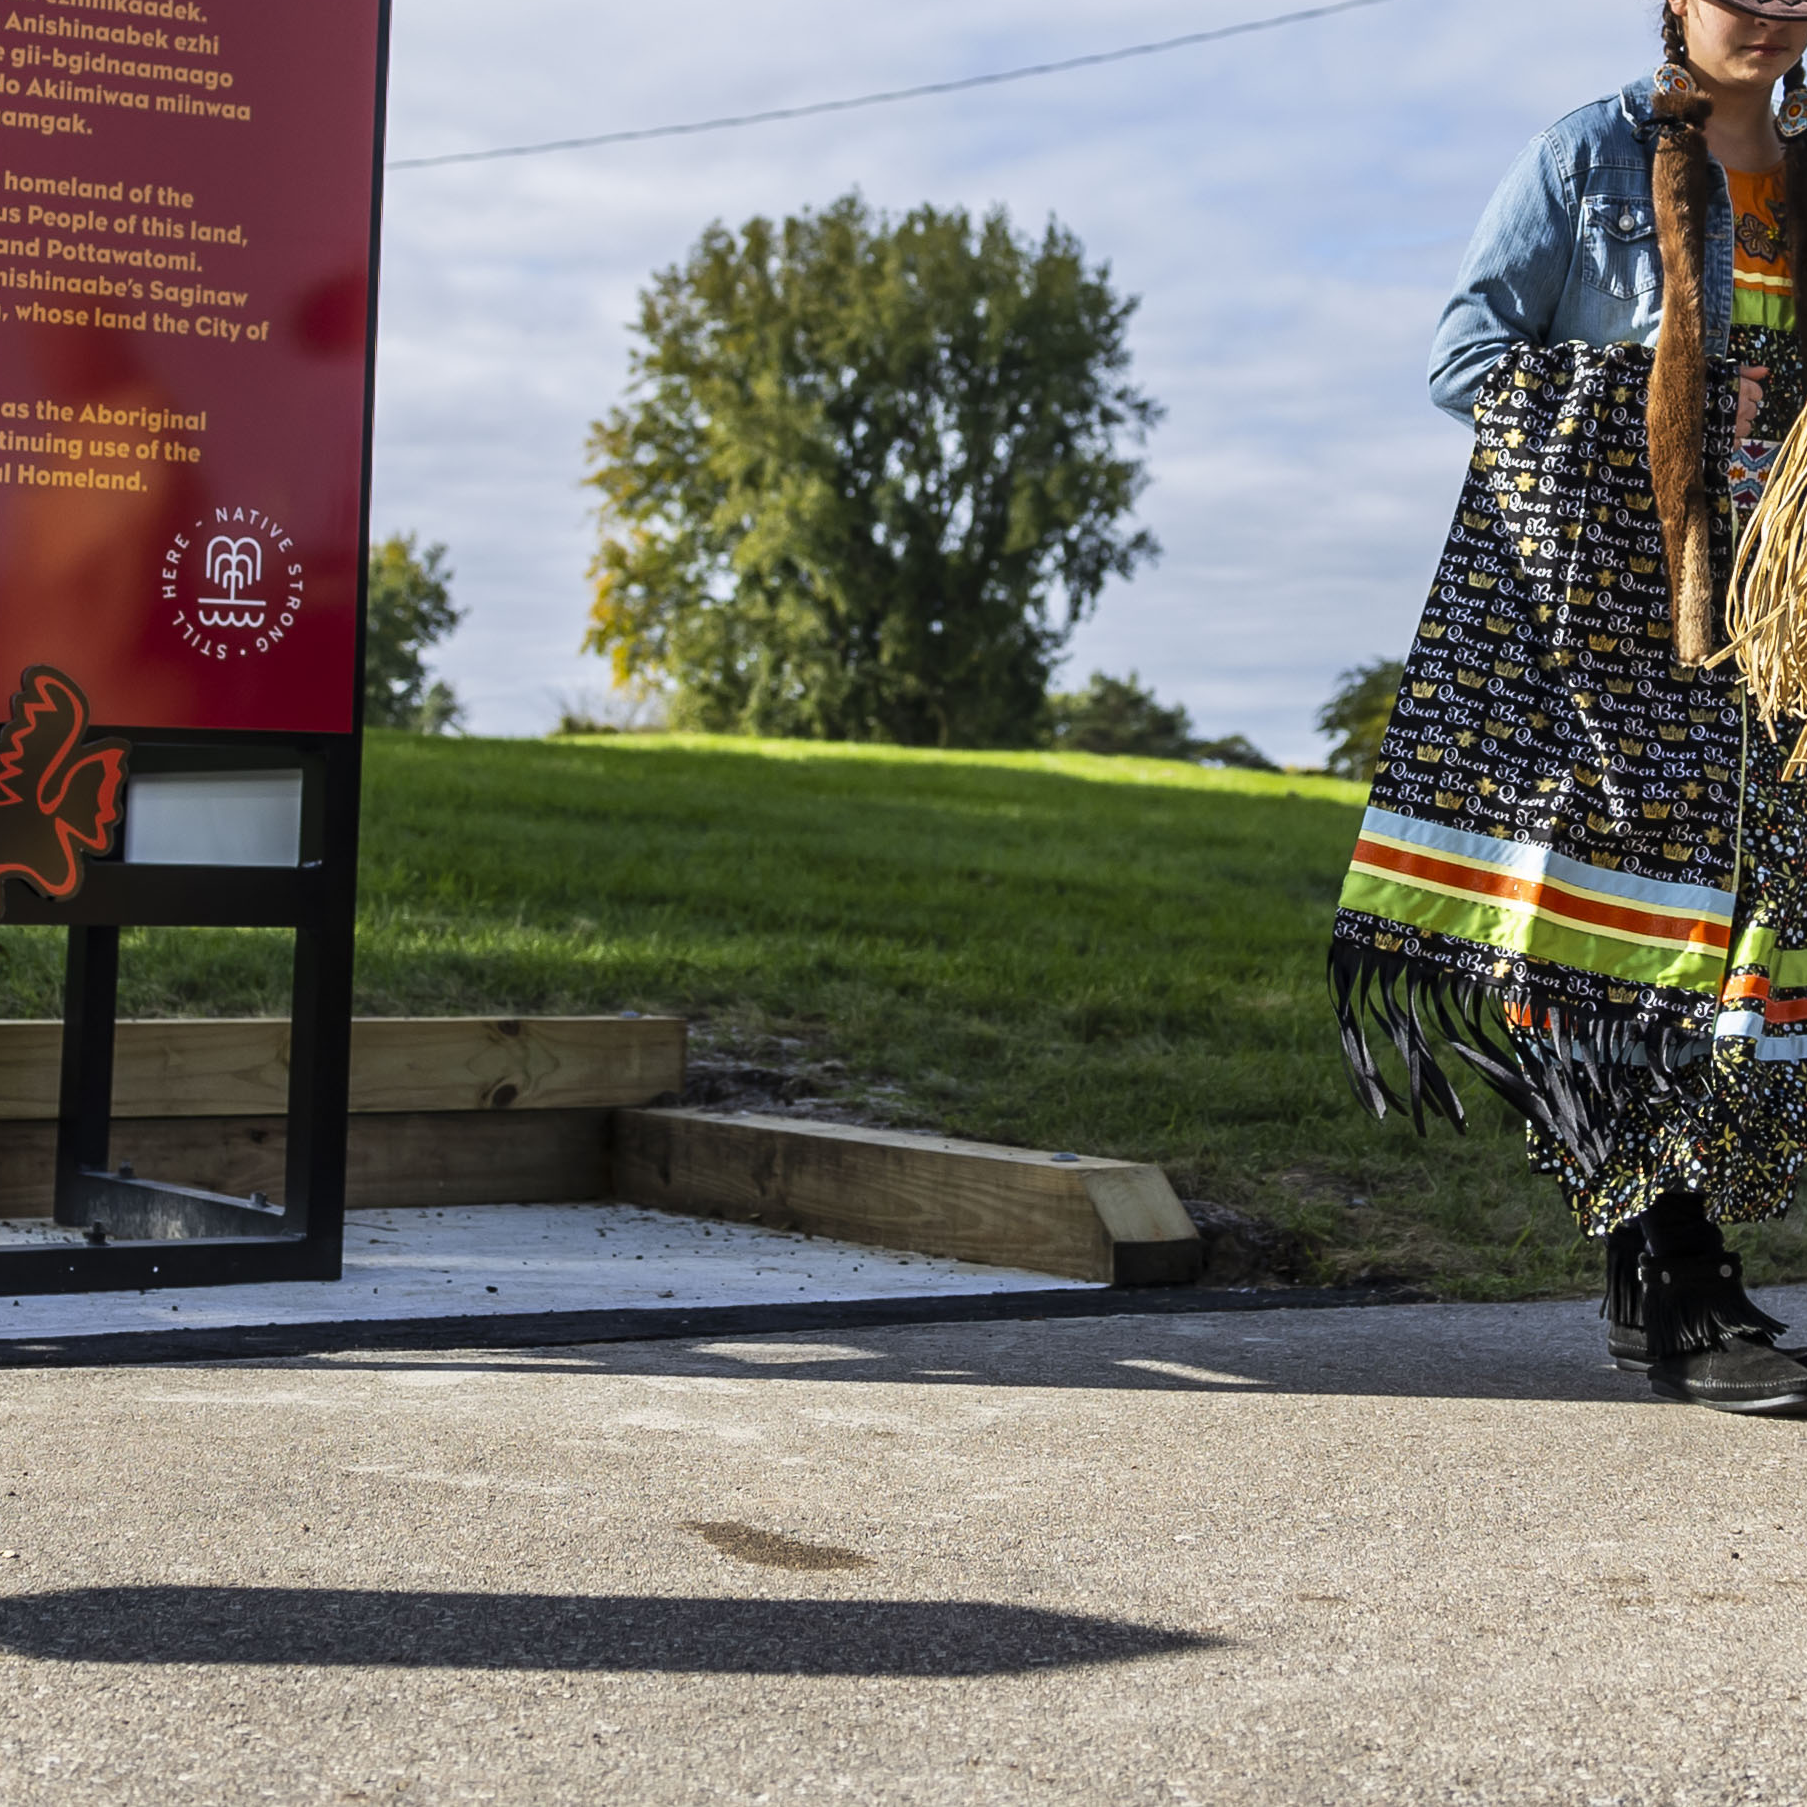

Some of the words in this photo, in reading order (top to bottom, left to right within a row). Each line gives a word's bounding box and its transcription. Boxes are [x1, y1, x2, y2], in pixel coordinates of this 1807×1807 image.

[4, 10, 169, 50] Anishinaabek
[174, 33, 219, 56] ezhi
[10, 44, 234, 91] gii-bgidnaamaago
[25, 77, 150, 110] Akiimiwaa
[155, 93, 251, 121] miinwaa
[4, 169, 124, 202] homeland
[128, 184, 153, 204] of
[157, 186, 195, 209] the
[27, 204, 109, 234] People
[113, 214, 138, 235] of
[141, 216, 185, 239] this
[190, 220, 248, 248] land,
[46, 238, 203, 272] Pottawatomi.
[149, 280, 249, 308] Saginaw
[14, 301, 89, 326] whose
[94, 306, 147, 331] land
[152, 312, 190, 335] the
[195, 315, 242, 343] City
[246, 320, 270, 341] of
[0, 401, 30, 419] as
[35, 399, 74, 422] the
[78, 403, 207, 433] Aboriginal
[89, 440, 131, 459] use
[135, 439, 160, 460] of
[163, 441, 201, 463] the
[17, 463, 148, 492] Homeland.
[162, 533, 190, 599] HERE
[215, 506, 293, 553] NATIVE
[256, 563, 304, 653] STRONG
[172, 610, 228, 660] STILL
